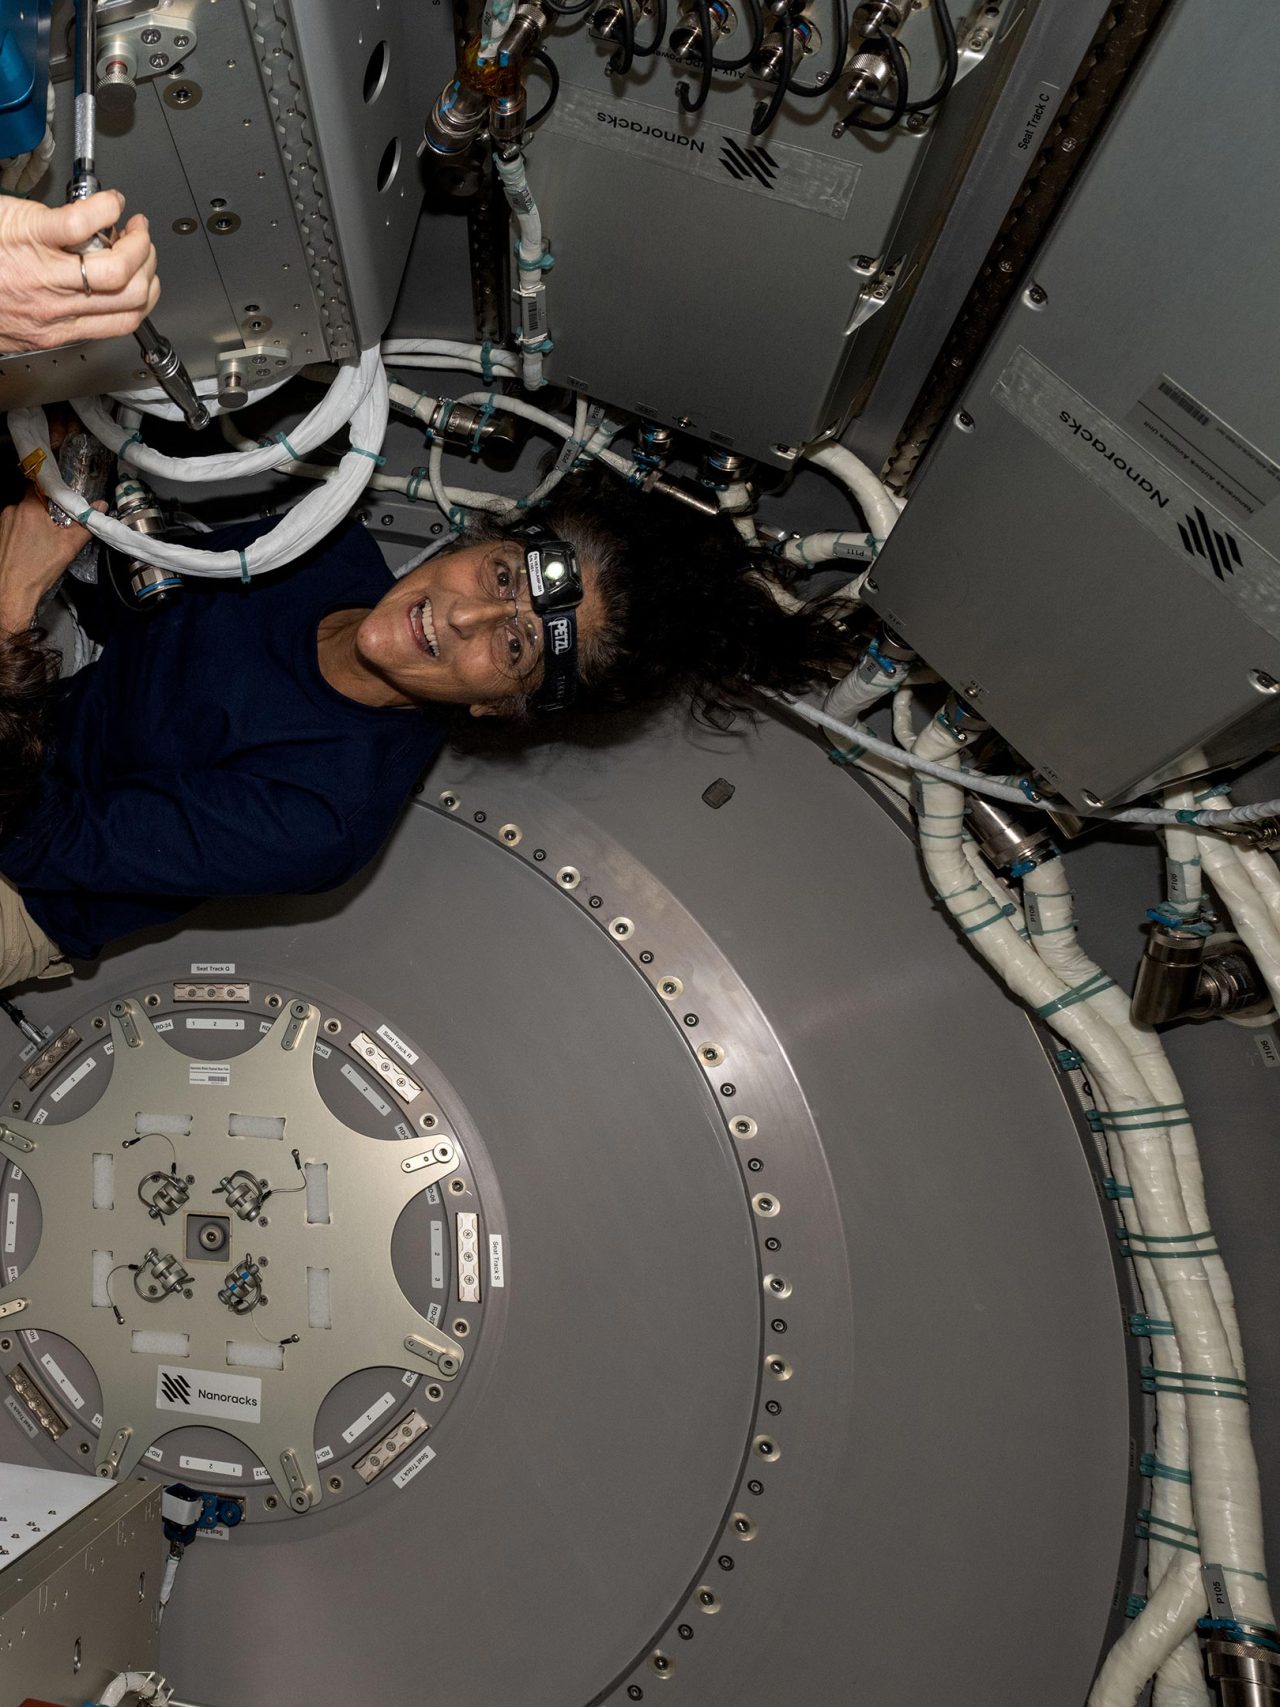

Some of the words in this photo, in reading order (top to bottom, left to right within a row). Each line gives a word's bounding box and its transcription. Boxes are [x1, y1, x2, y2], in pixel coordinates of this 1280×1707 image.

[597, 111, 704, 153] Nanoracks
[1018, 129, 1033, 150] Seat
[1027, 103, 1046, 129] Track
[1039, 93, 1050, 102] C
[1059, 410, 1170, 509] Nanoracks
[847, 549, 865, 557] P111
[548, 619, 568, 655] PETZL
[382, 1030, 393, 1042] Seat
[391, 1039, 407, 1054] Track
[1260, 1040, 1275, 1061] J106
[198, 1389, 258, 1407] Nanoracks
[405, 1461, 420, 1476] Track
[419, 1452, 429, 1463] Seat
[1212, 1581, 1225, 1604] P105
